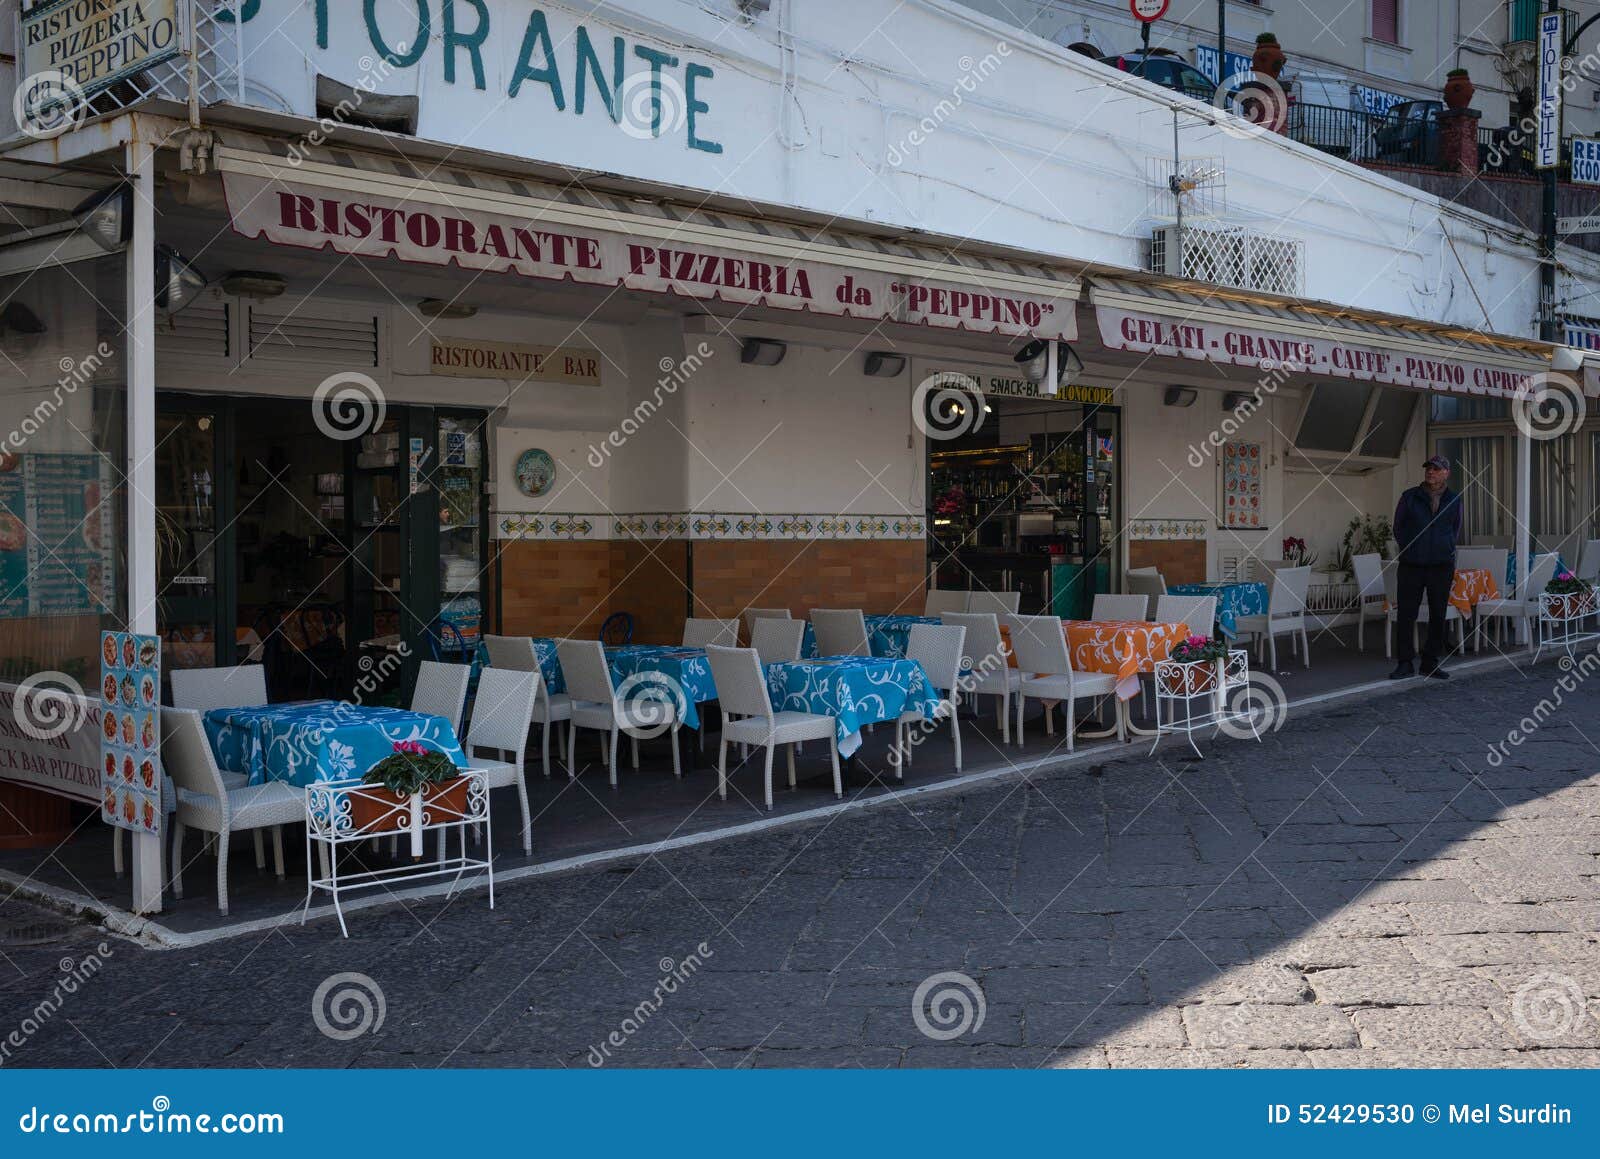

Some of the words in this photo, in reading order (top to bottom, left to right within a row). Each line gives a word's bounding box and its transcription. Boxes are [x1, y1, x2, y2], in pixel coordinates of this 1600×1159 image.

[50, 2, 146, 65] PIZZERIA
[59, 17, 173, 91] PEPPINO
[1197, 47, 1227, 88] REN
[276, 191, 602, 270] RISTORANTE
[626, 243, 813, 299] PIZZERIA
[836, 275, 872, 306] da
[432, 345, 545, 374] RISTORANTE
[564, 355, 598, 378] BAR
[1121, 316, 1205, 350] GELATI
[1224, 331, 1316, 365] GRANITE
[1406, 357, 1465, 386] PANINO
[1473, 367, 1537, 395] CAPRESE
[990, 377, 1046, 398] SNACK-BA
[22, 751, 48, 776] BAR
